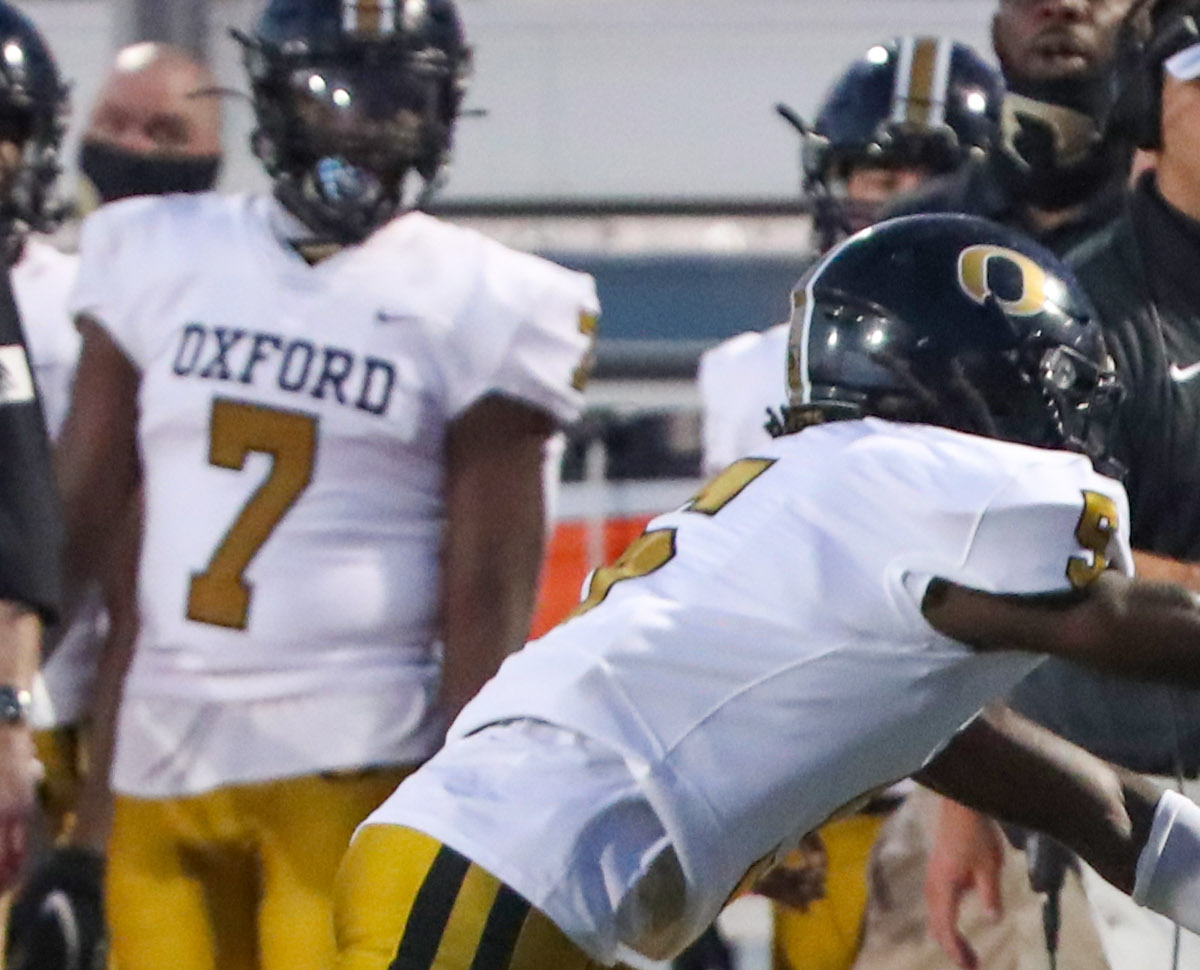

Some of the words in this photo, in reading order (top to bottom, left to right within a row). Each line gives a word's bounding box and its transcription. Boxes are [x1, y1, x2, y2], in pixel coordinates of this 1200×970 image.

[957, 243, 1069, 318] O
[172, 321, 397, 416] OXFORD
[184, 395, 320, 632] 7
